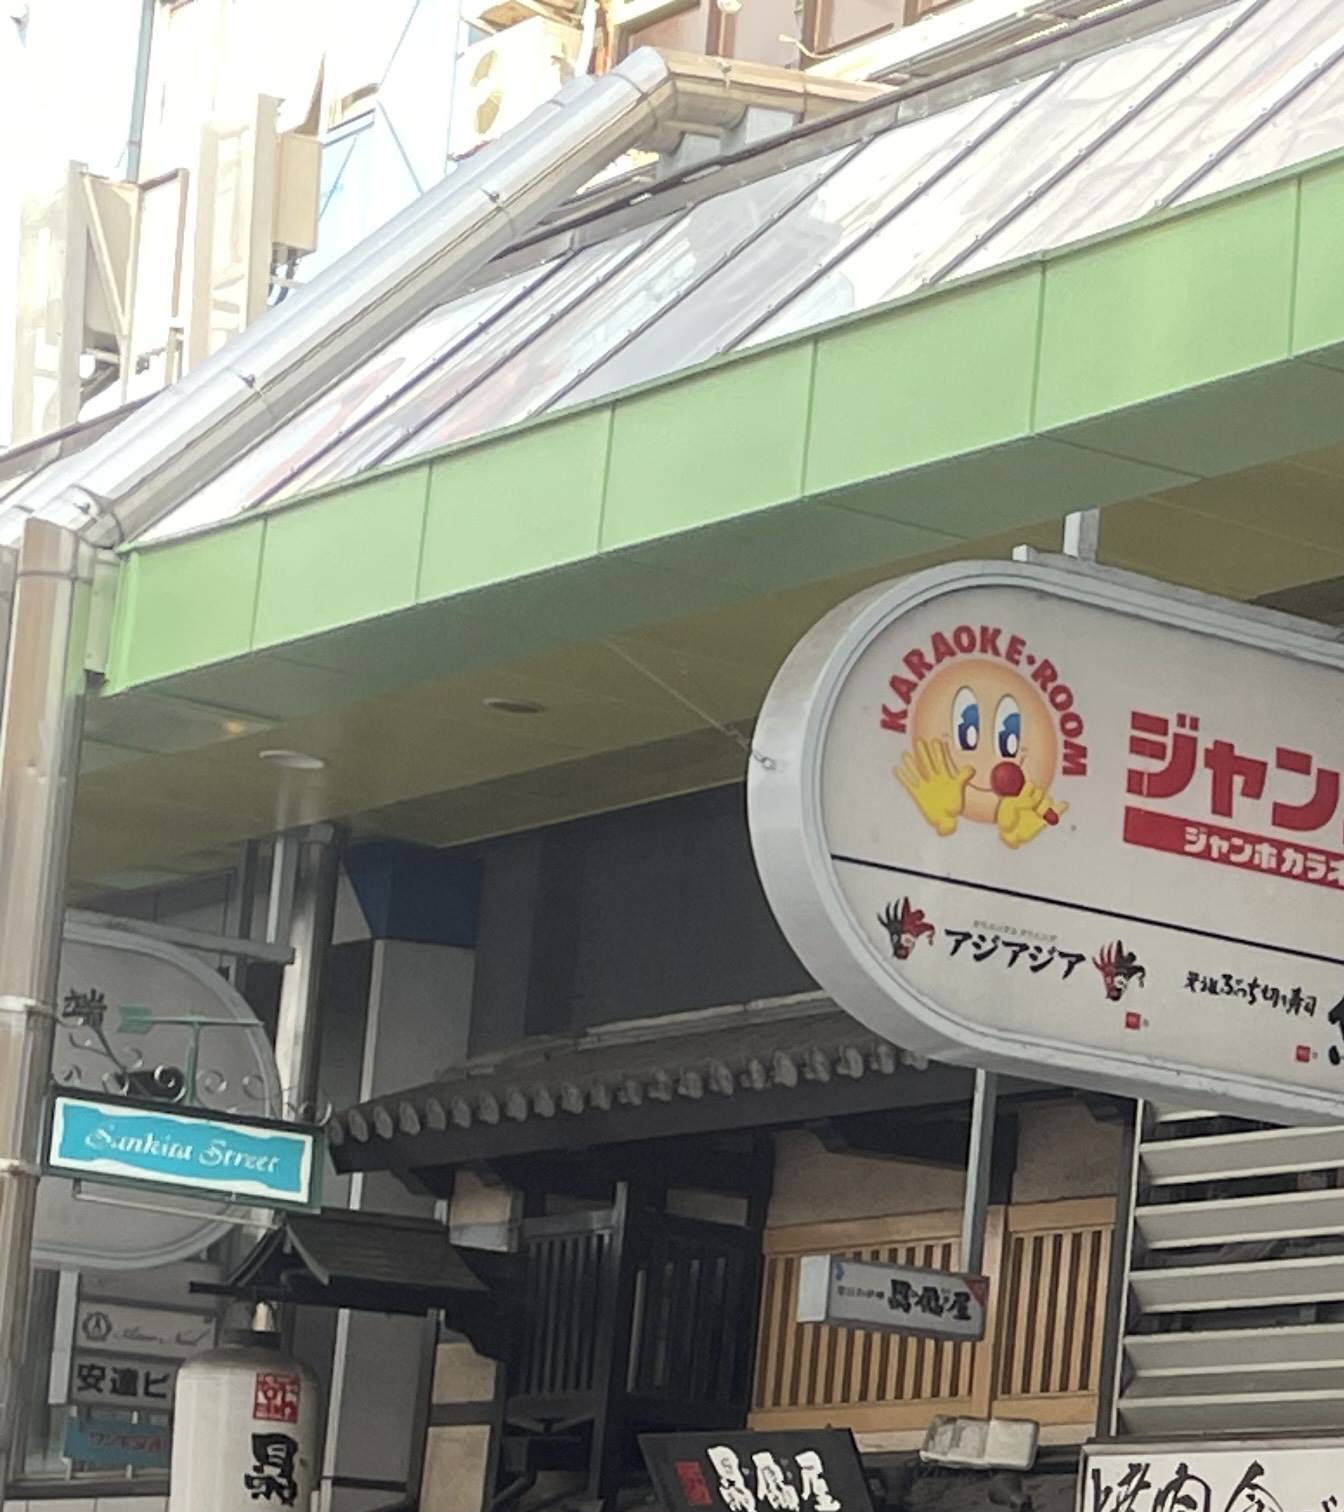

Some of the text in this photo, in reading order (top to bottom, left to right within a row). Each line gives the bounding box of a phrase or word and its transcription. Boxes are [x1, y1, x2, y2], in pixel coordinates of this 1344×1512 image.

[944, 928, 1086, 980] アジアジア
[84, 1124, 280, 1173] Sankita Street
